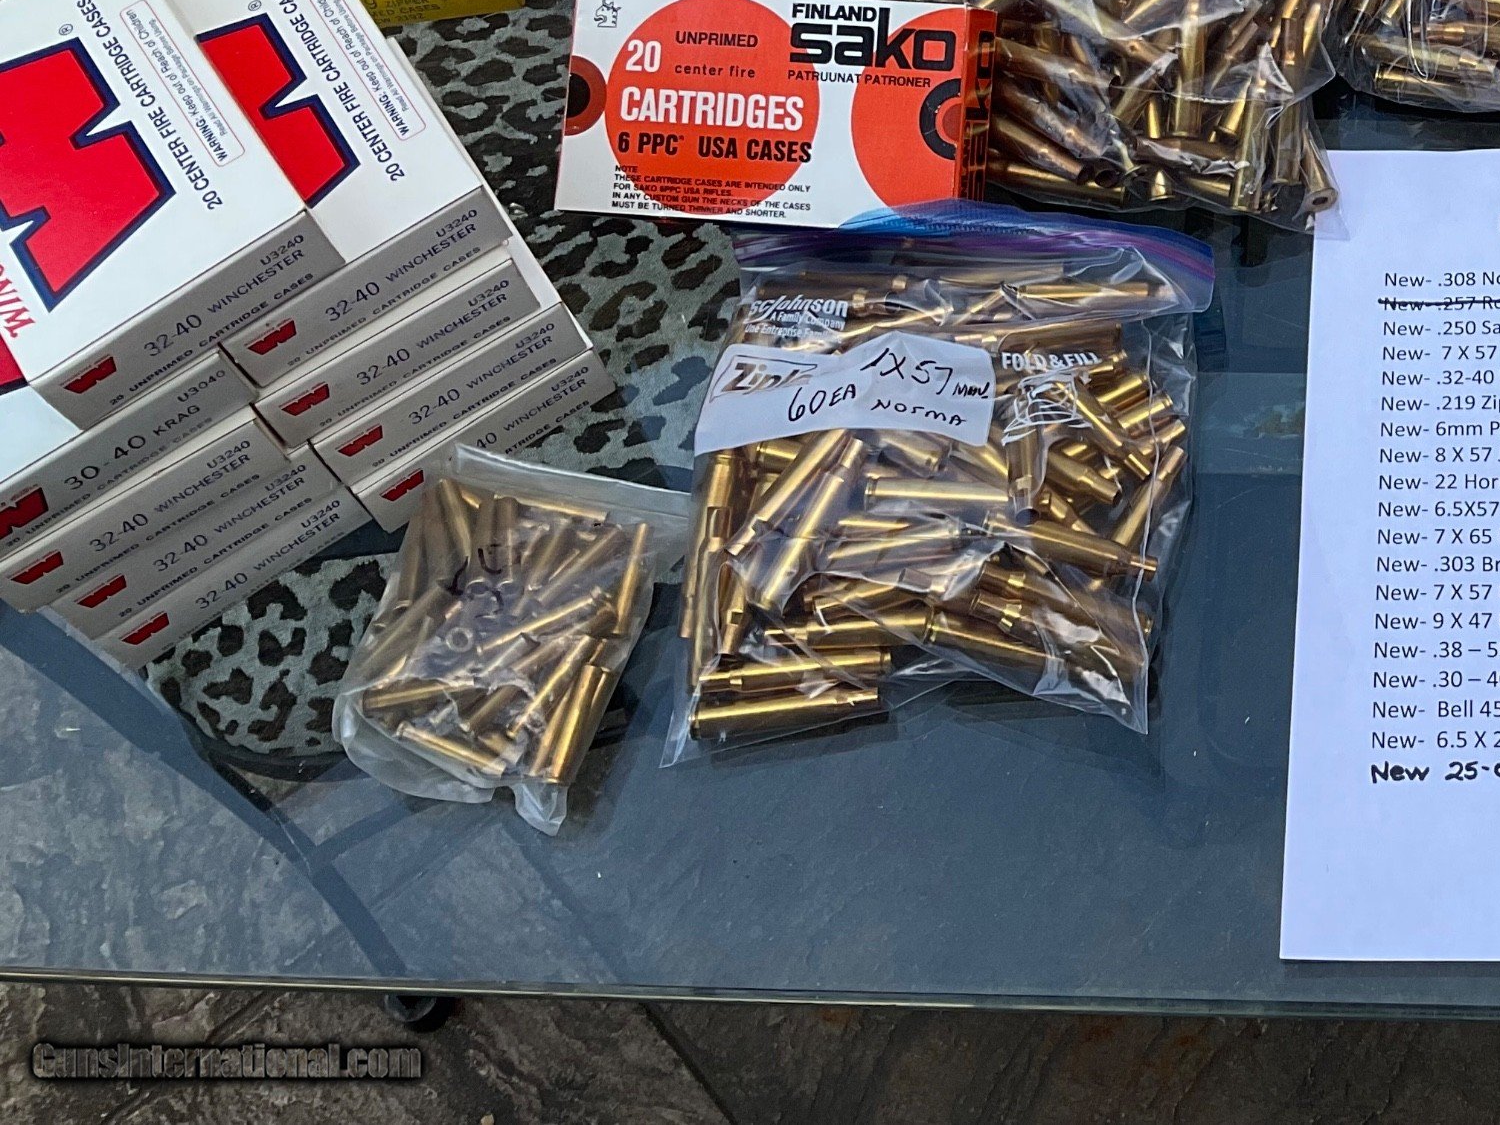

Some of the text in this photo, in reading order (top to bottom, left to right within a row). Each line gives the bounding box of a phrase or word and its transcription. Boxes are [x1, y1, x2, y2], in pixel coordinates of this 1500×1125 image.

[792, 3, 877, 22] FINLAND
[290, 14, 341, 83] CARTRIDGE
[675, 31, 758, 48] UNPRIMED
[789, 7, 956, 72] sako
[626, 39, 662, 72] 20
[675, 63, 756, 78] center fire
[787, 70, 931, 88] PATRUUNAT PATRONER
[333, 84, 360, 112] FIRE
[620, 86, 804, 131] CARTRIDGES
[353, 108, 392, 163] CENTER
[618, 132, 629, 154] 6
[698, 136, 738, 159] USA
[747, 139, 812, 164] CASES
[385, 158, 405, 182] 20
[258, 234, 305, 266] U3240
[1385, 273, 1432, 287] New-
[1438, 272, 1476, 287] .308
[143, 248, 306, 358] 32-40 WINCHESTER
[1384, 321, 1431, 336] New-
[1438, 321, 1477, 337] .250
[1002, 352, 1047, 370] FOLD
[1050, 354, 1064, 368] &
[176, 369, 227, 405] U3040
[150, 403, 202, 437] KRAG
[1377, 557, 1428, 573] New-
[1434, 556, 1475, 572] .303
[1371, 761, 1430, 784] New
